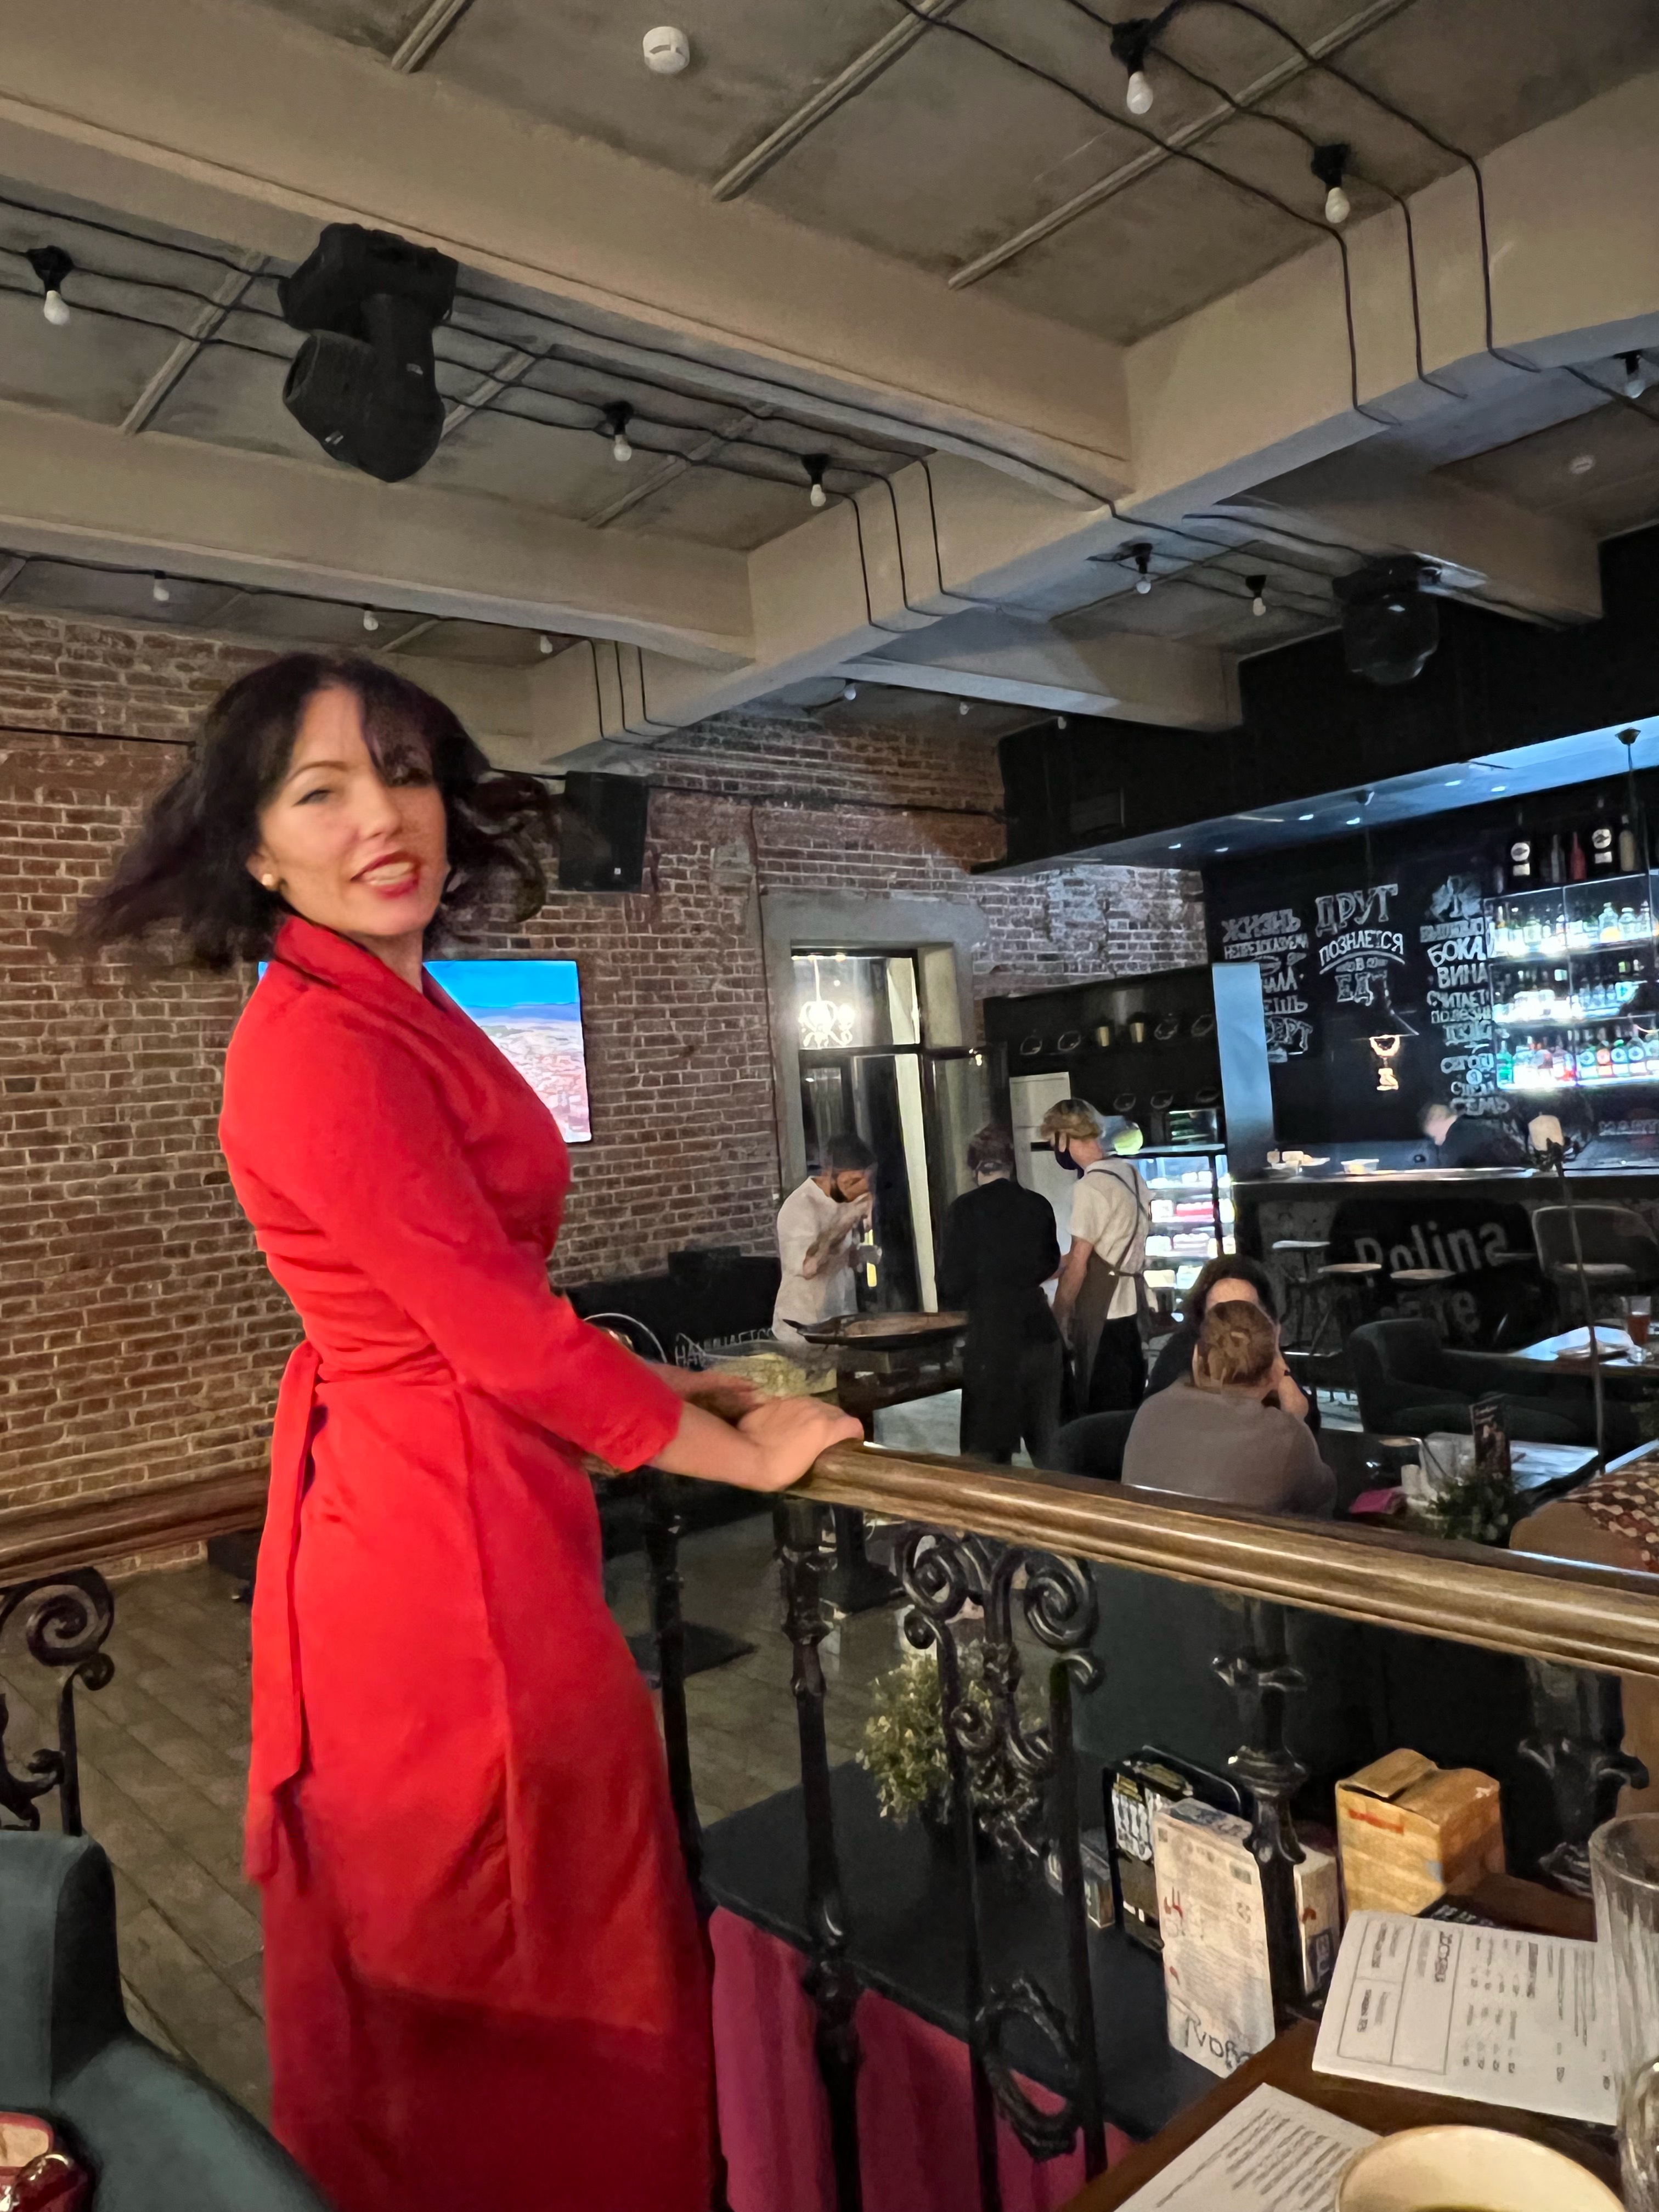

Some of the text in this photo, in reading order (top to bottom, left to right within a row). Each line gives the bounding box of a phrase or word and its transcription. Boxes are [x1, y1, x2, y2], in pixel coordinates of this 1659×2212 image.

[1319, 930, 1404, 967] ПОЗНАЕТСЯ
[1437, 962, 1488, 989] ВИНА
[1355, 1220, 1508, 1288] Polina
